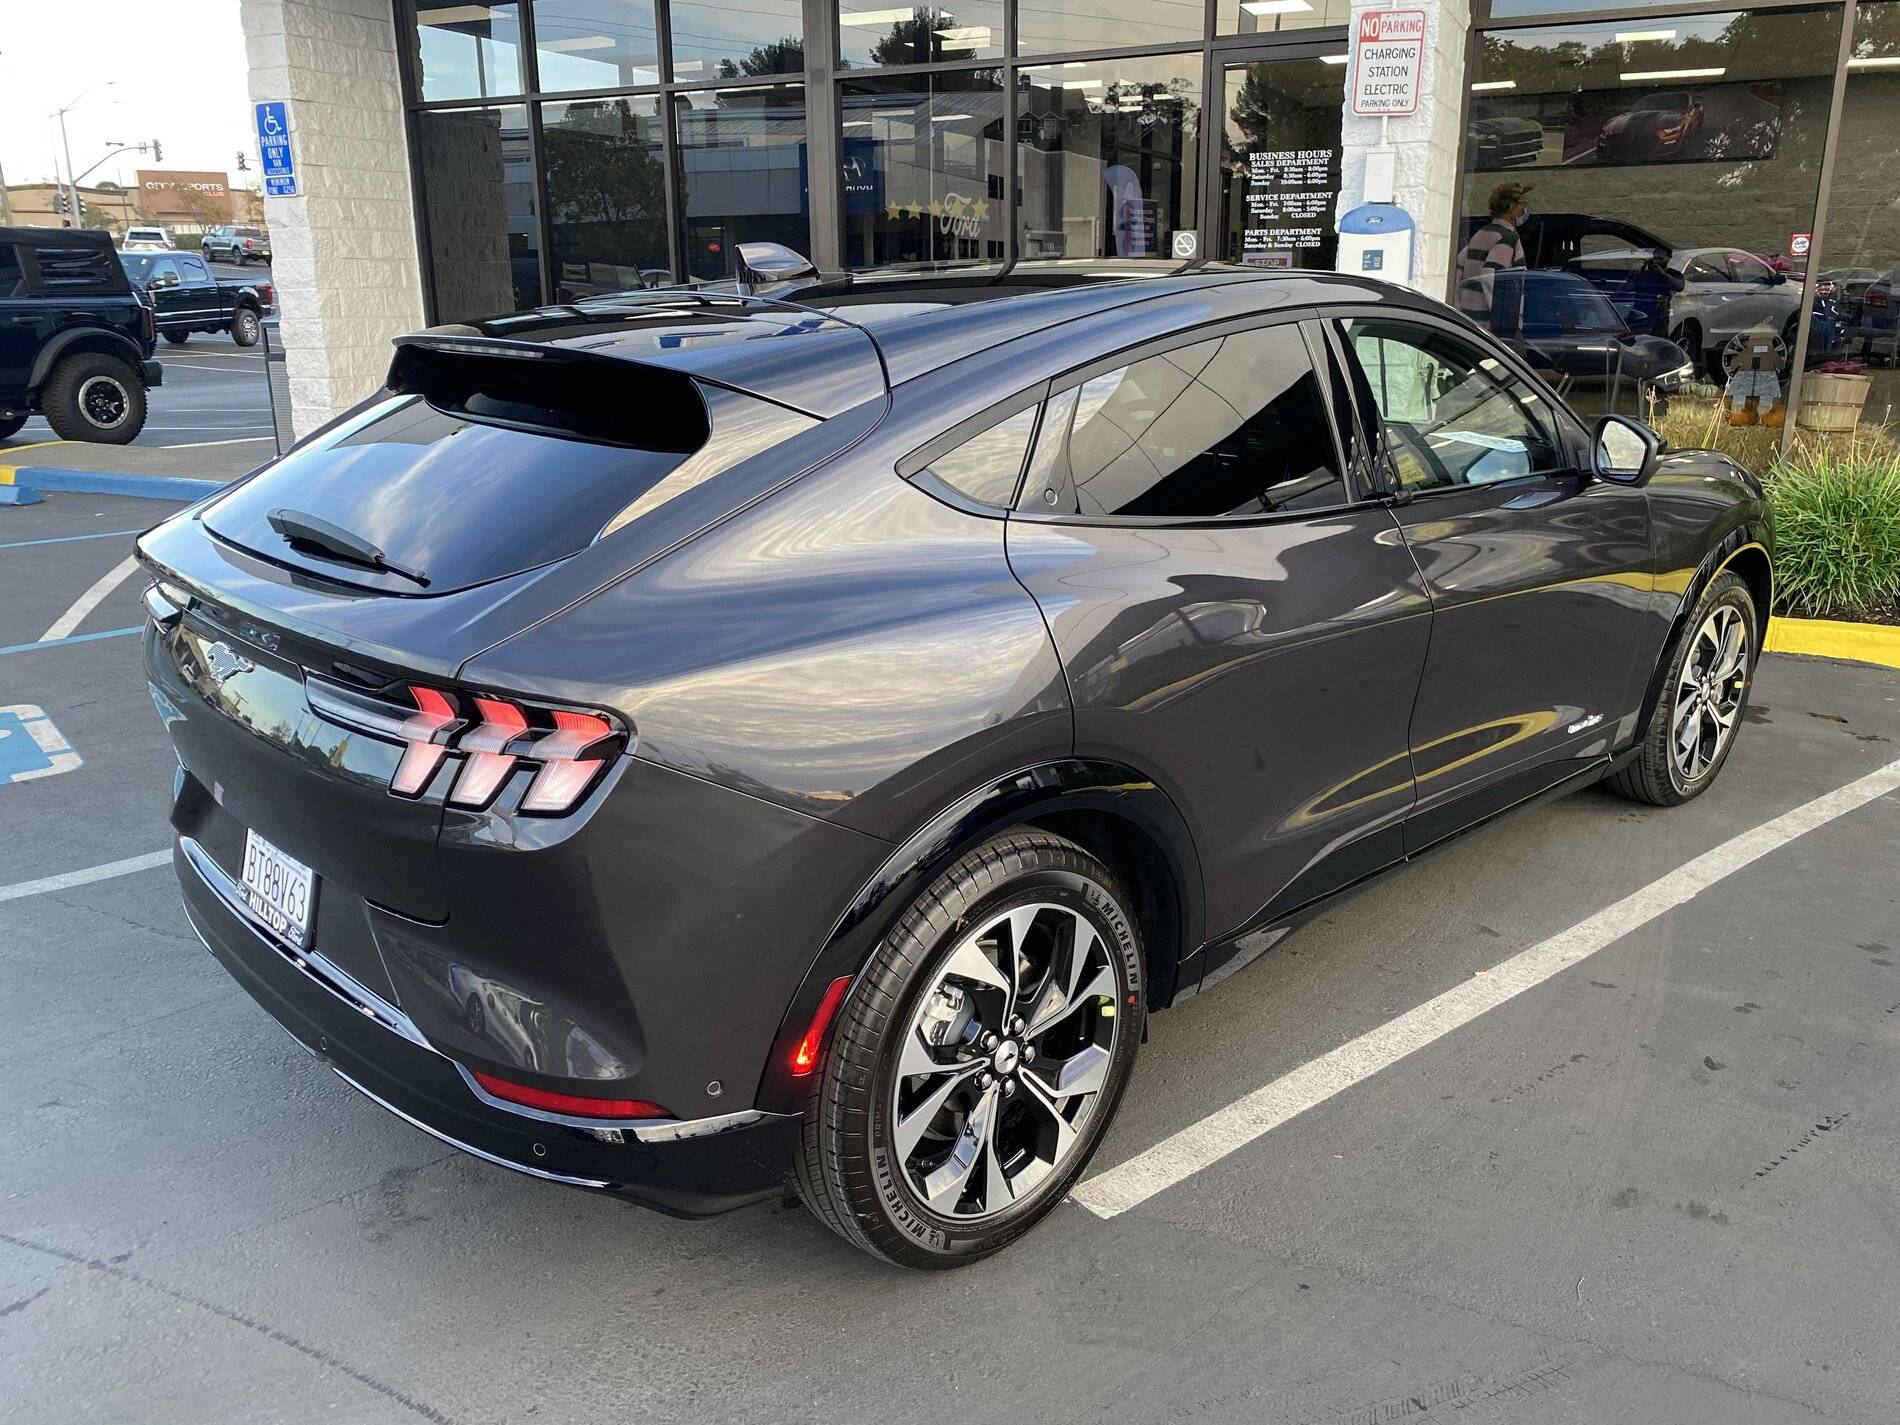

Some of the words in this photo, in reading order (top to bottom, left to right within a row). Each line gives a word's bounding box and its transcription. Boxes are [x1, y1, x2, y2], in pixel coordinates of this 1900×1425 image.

[1361, 18, 1379, 38] NO
[1381, 20, 1422, 33] PARKING
[1364, 48, 1416, 60] CHARGING
[1368, 66, 1408, 77] STATION
[1364, 84, 1409, 95] ELECTRIC
[260, 135, 288, 147] PARKING
[267, 148, 283, 159] ONLY
[1249, 151, 1295, 160] BUSINESS
[1298, 150, 1332, 158] HOURS
[940, 192, 980, 237] Ford
[247, 844, 306, 922] BT88V63
[248, 891, 287, 932] HILLTOP
[1101, 902, 1138, 984] MICHELIN
[877, 1155, 926, 1238] MICHELIN
